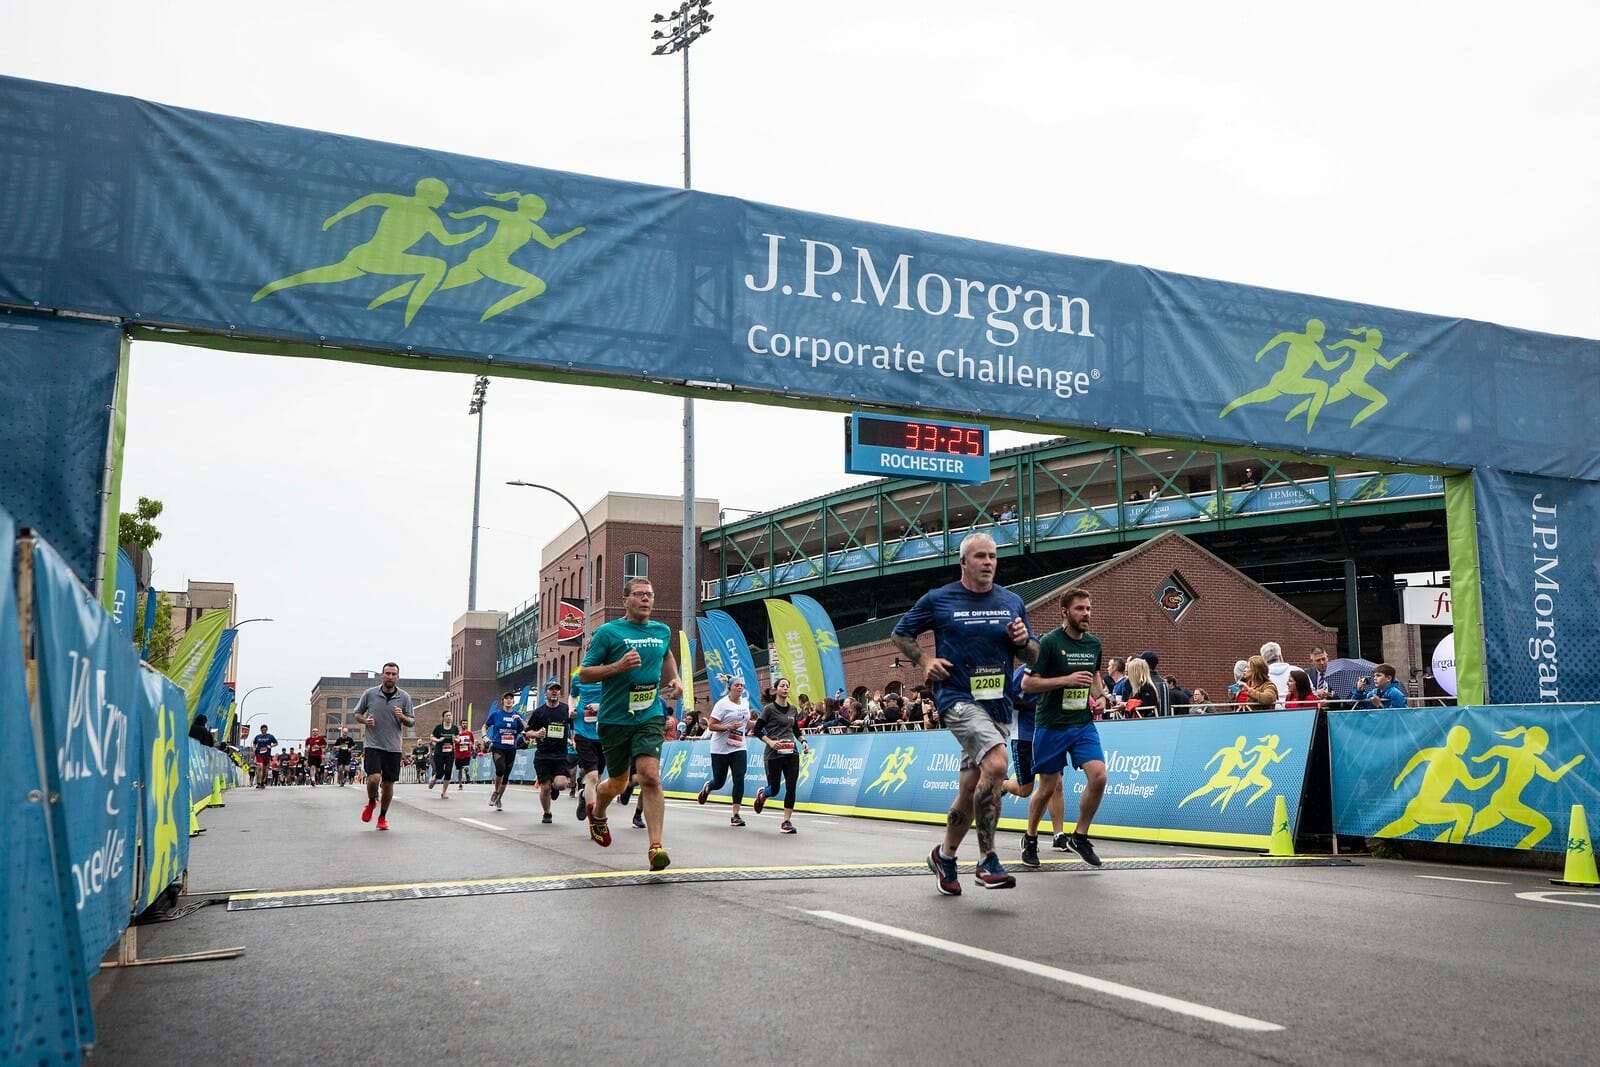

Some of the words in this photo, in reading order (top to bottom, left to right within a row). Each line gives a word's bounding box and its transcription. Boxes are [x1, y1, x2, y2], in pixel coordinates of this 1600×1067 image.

[744, 232, 1095, 347] J.P.Morgan
[746, 324, 926, 374] Corporate
[905, 423, 981, 456] 33:25
[880, 453, 964, 474] ROCHESTER
[113, 589, 126, 628] CHA
[972, 609, 1011, 617] DIFFERENCE
[785, 631, 812, 698] #JPMCC
[975, 677, 1001, 690] 2208
[633, 691, 654, 703] 2892
[1067, 690, 1086, 699] 2121
[823, 753, 864, 775] J.P.Morgan
[922, 779, 950, 792] Corporate
